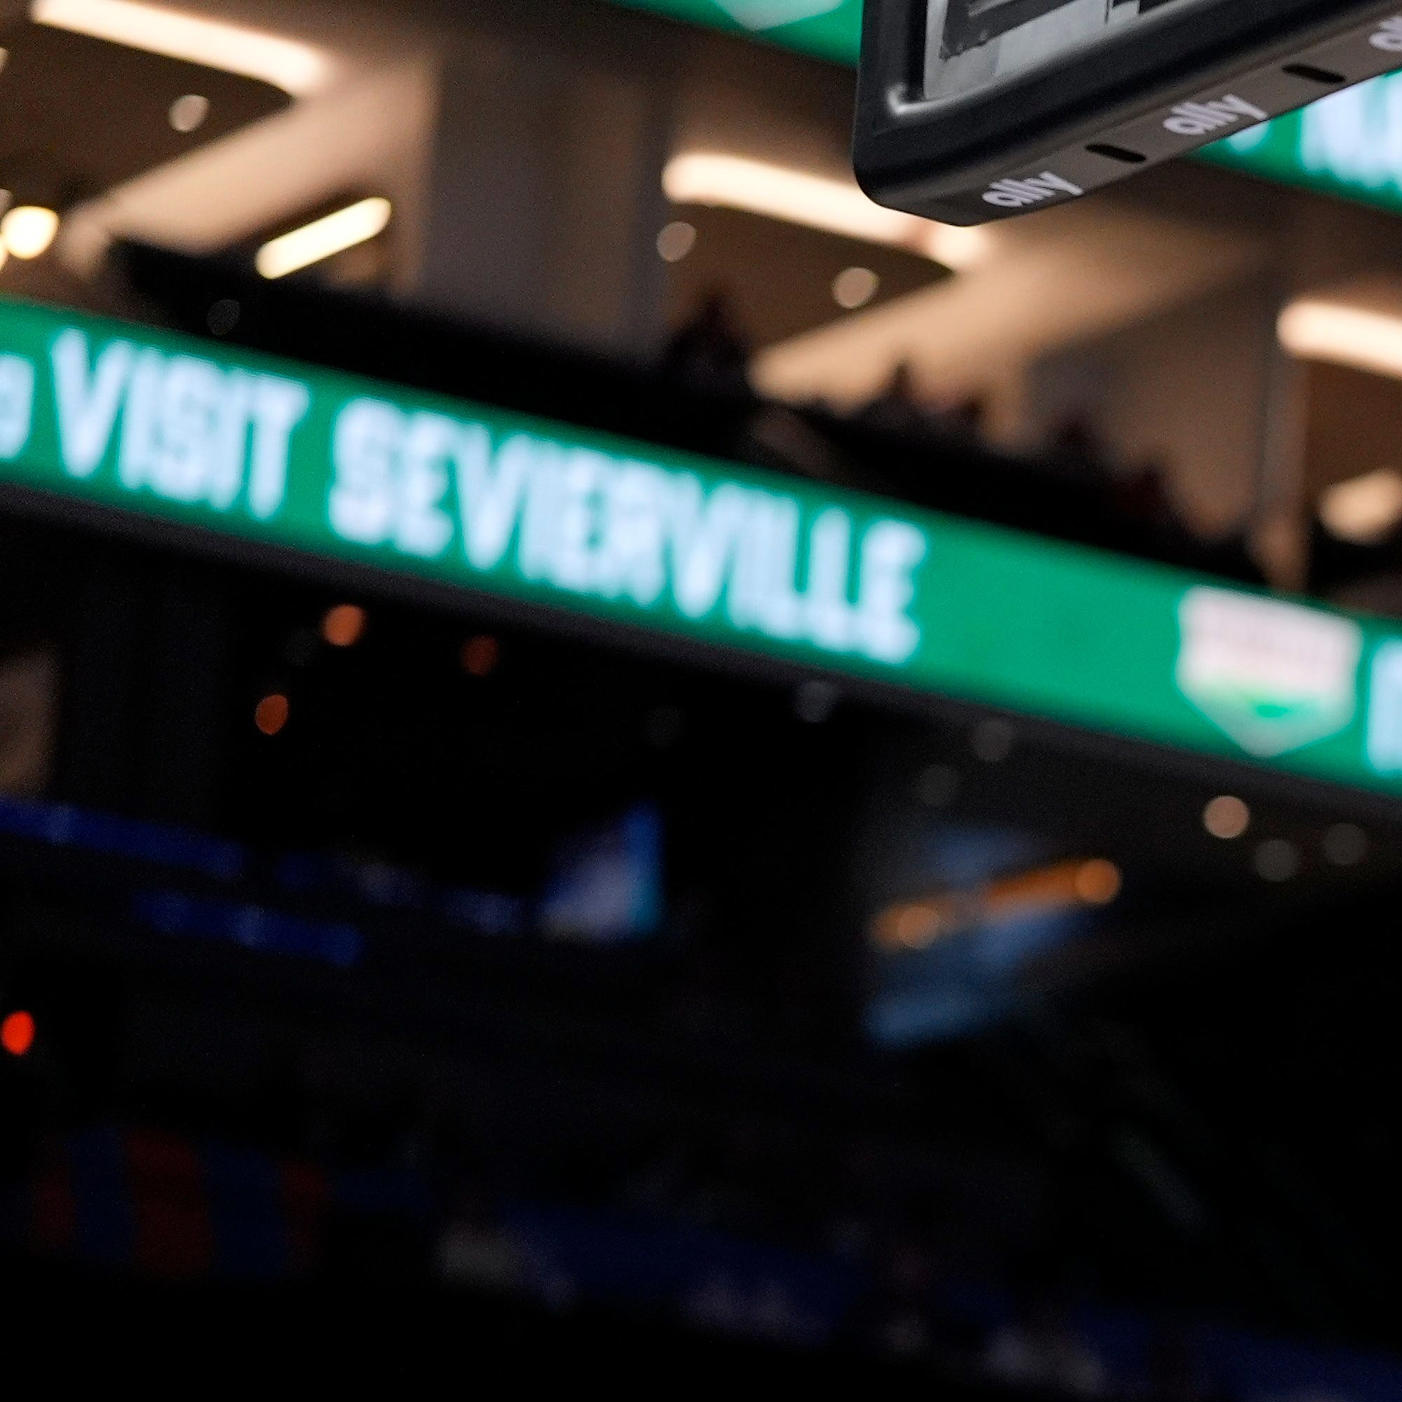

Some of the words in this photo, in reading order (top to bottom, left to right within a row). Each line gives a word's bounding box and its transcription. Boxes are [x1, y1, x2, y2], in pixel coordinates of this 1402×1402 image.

[1163, 93, 1268, 136] ally
[982, 170, 1085, 208] ally
[51, 326, 310, 522] VISIT
[326, 396, 928, 666] SEVIERVILLE
